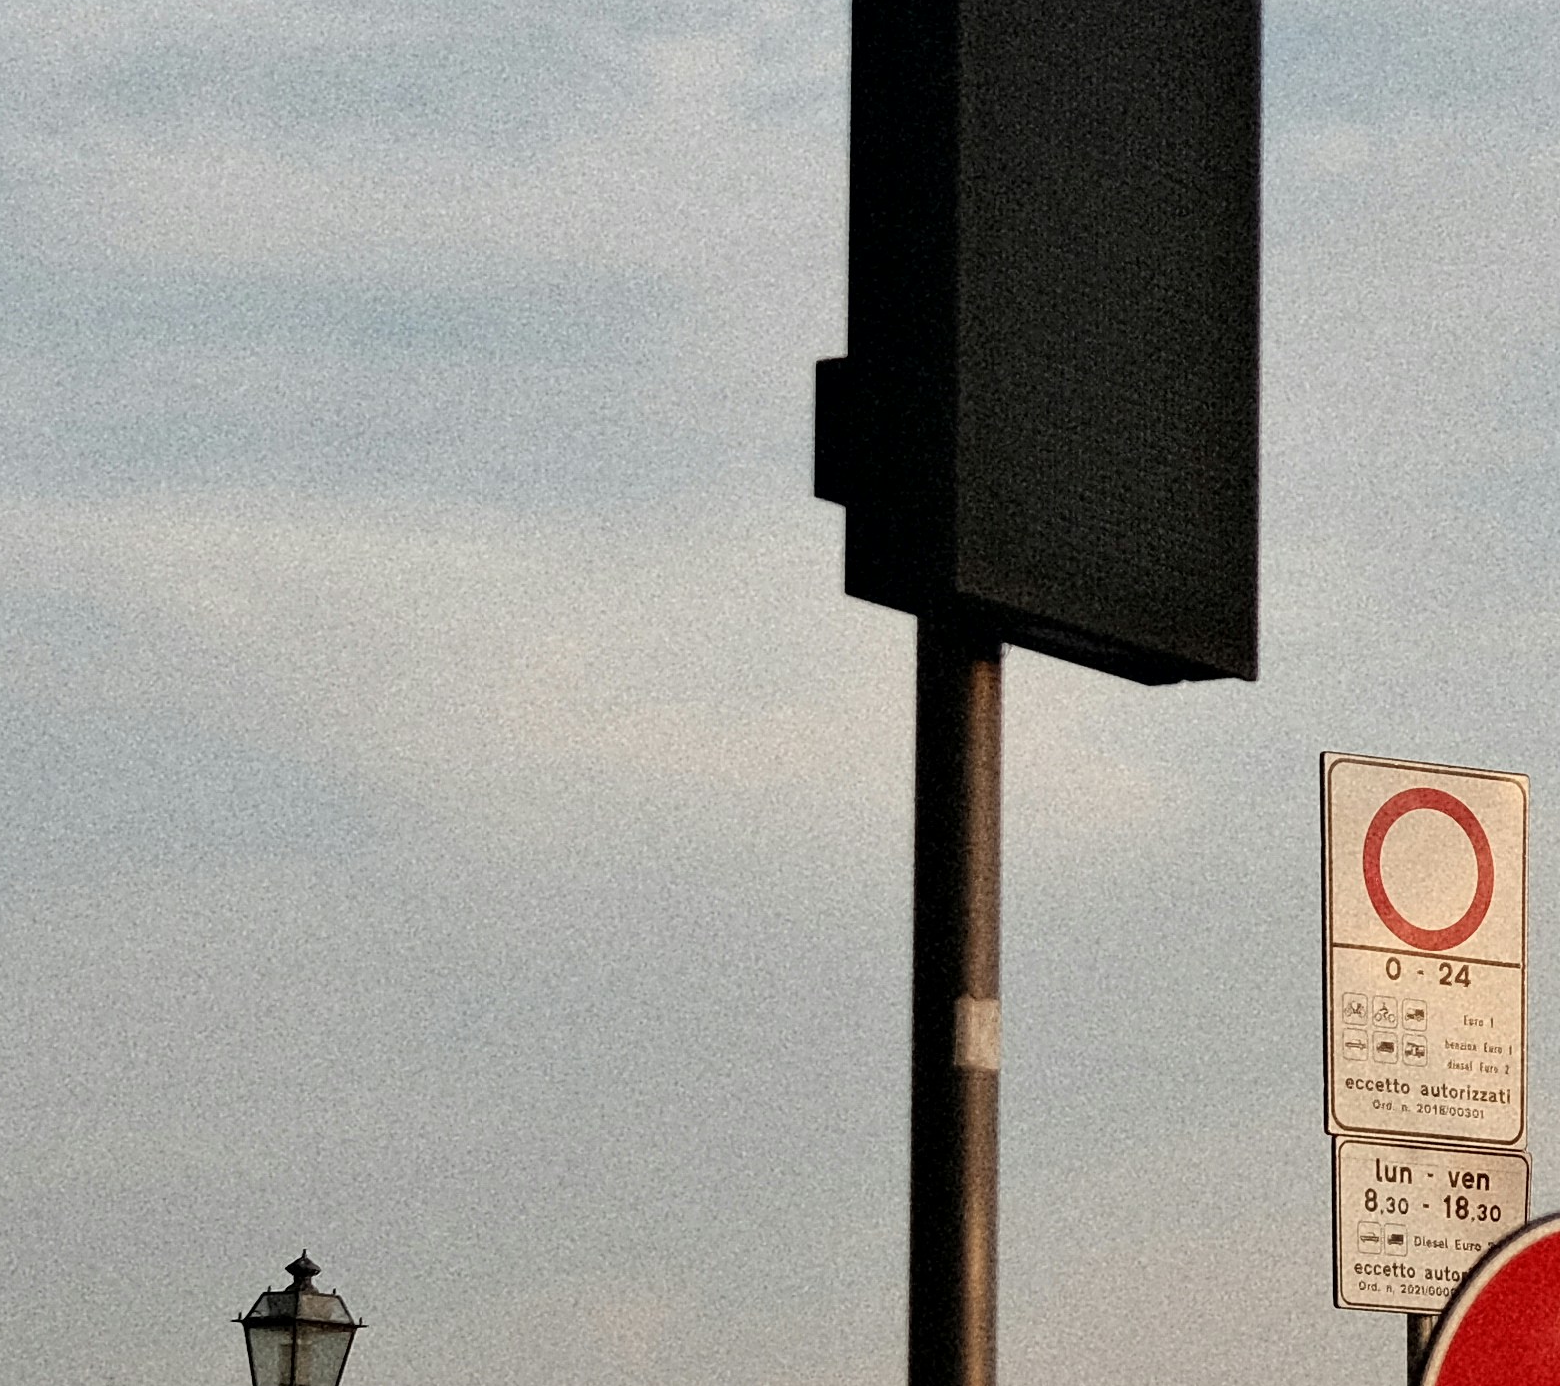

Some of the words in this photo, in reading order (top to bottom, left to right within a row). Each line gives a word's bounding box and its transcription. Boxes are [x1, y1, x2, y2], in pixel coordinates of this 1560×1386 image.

[1385, 956, 1402, 981] 0
[1438, 962, 1472, 988] 24
[1463, 1014, 1484, 1027] Euro
[1483, 1041, 1503, 1055] Euro
[1479, 1061, 1499, 1074] Euro
[1344, 1076, 1410, 1095] eccetto
[1419, 1082, 1512, 1104] autorizzati
[1375, 1157, 1413, 1184] lun
[1448, 1170, 1491, 1191] ven
[1413, 1235, 1448, 1249] Diesel
[1454, 1238, 1482, 1252] Euro
[1353, 1262, 1416, 1280] eccetto
[1424, 1265, 1471, 1283] autor
[1358, 1280, 1381, 1293] Ord.
